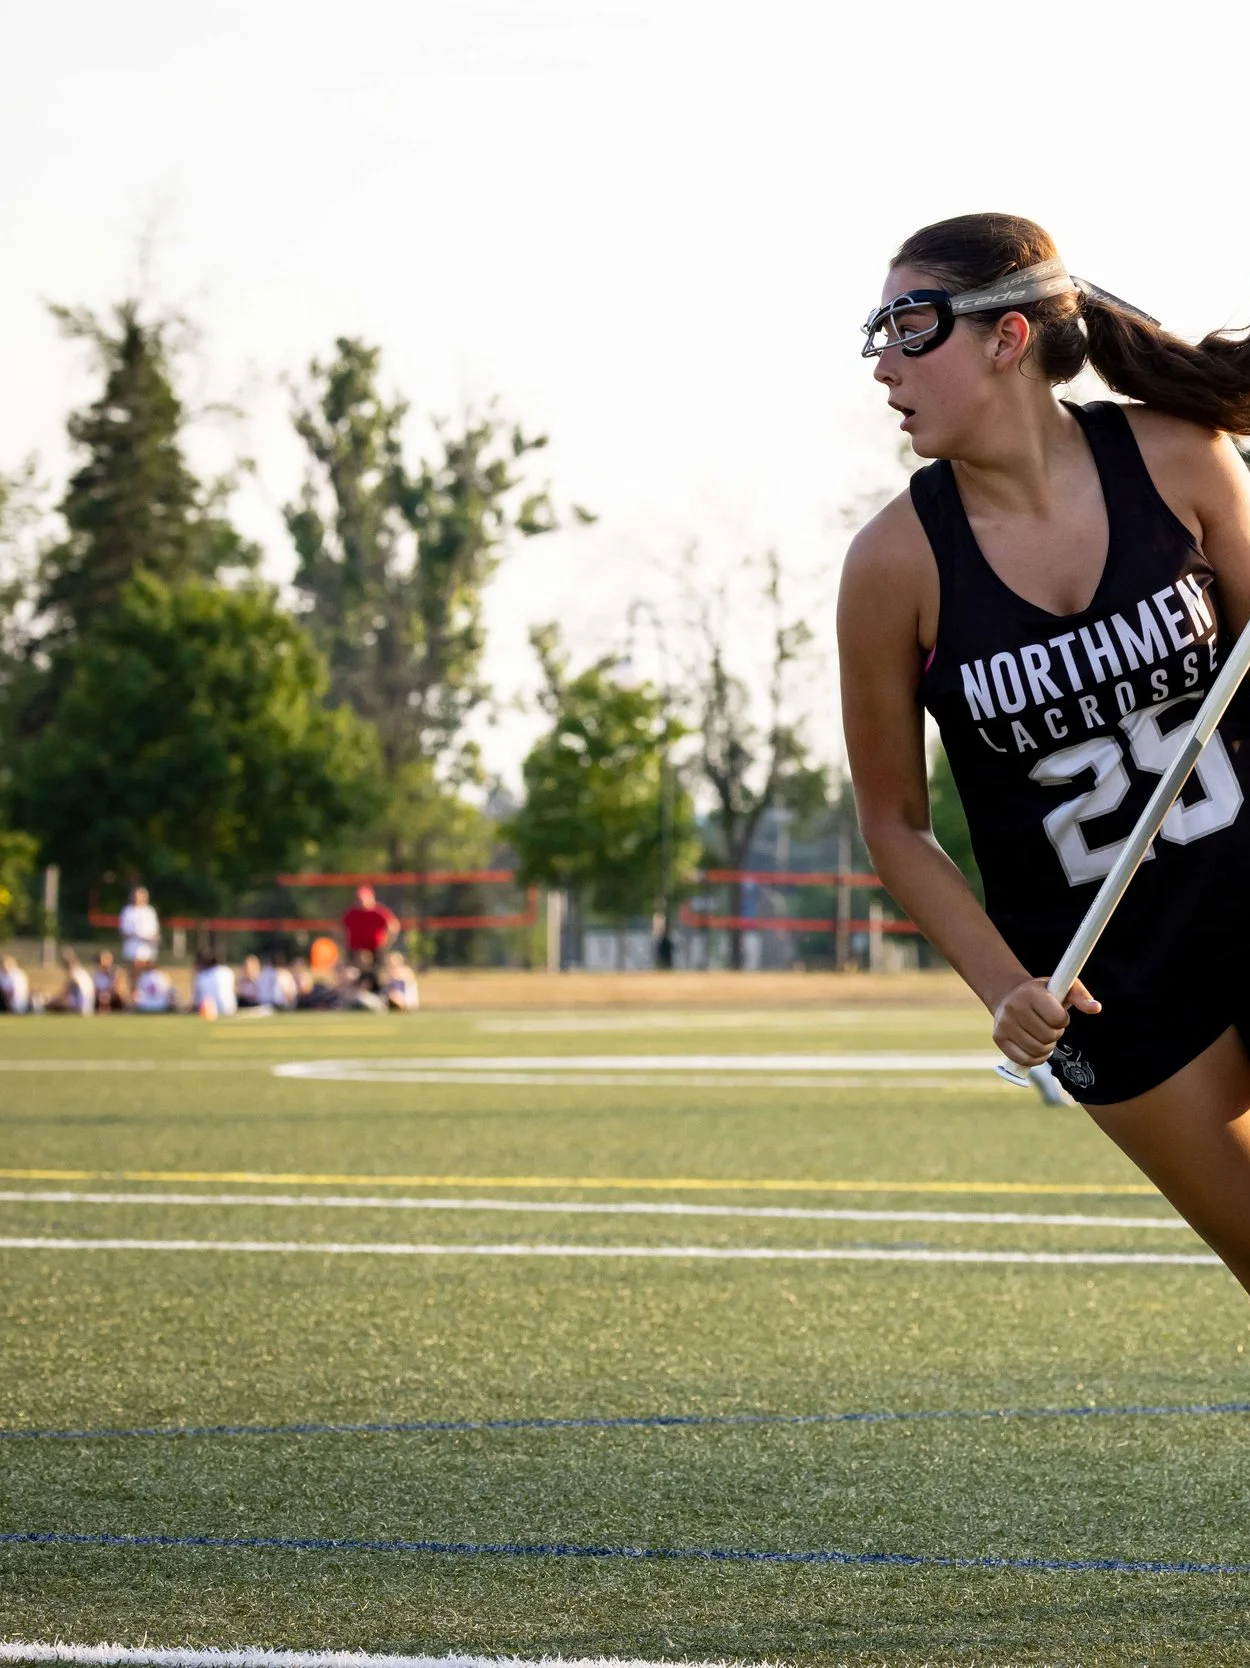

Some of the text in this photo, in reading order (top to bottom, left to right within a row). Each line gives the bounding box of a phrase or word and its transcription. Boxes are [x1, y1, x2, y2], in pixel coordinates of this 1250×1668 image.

[960, 573, 1213, 721] NORTHMEN
[978, 632, 1218, 753] LACROSSE
[1028, 690, 1244, 887] 25
